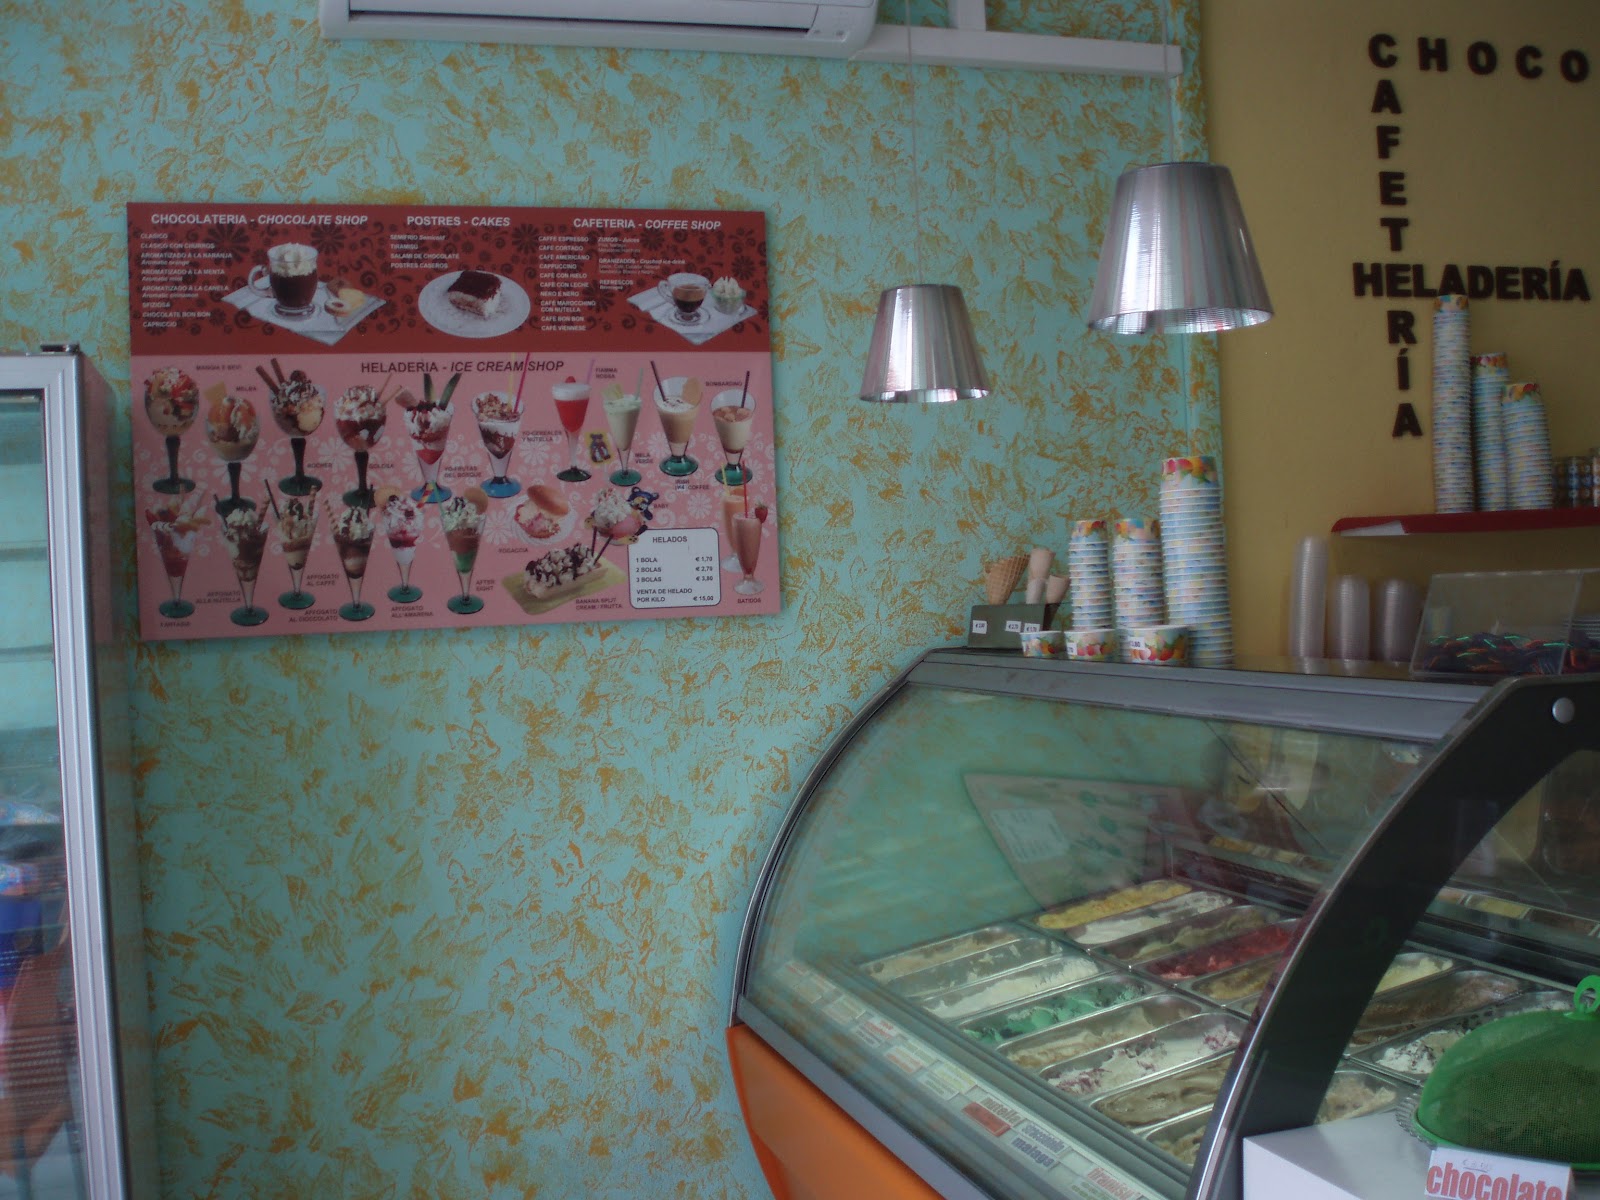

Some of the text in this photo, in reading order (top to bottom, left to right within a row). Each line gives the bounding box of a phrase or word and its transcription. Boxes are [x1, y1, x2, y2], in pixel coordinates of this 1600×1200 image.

[151, 213, 247, 225] CHOCOLATERIA
[258, 214, 332, 225] CHOCOLATE
[334, 215, 368, 225] SHOP
[407, 216, 461, 226] POSTRES
[471, 217, 511, 227] CAKES
[573, 218, 635, 229] CAFETERIA
[645, 219, 688, 230] COFFEE
[691, 220, 721, 230] SHOP
[1352, 260, 1591, 301] HELADERÍA
[361, 362, 438, 373] HELADERIA
[450, 361, 473, 372] ICE
[476, 361, 524, 372] CREAM
[527, 360, 564, 371] SHOP
[652, 536, 688, 544] HELADOS
